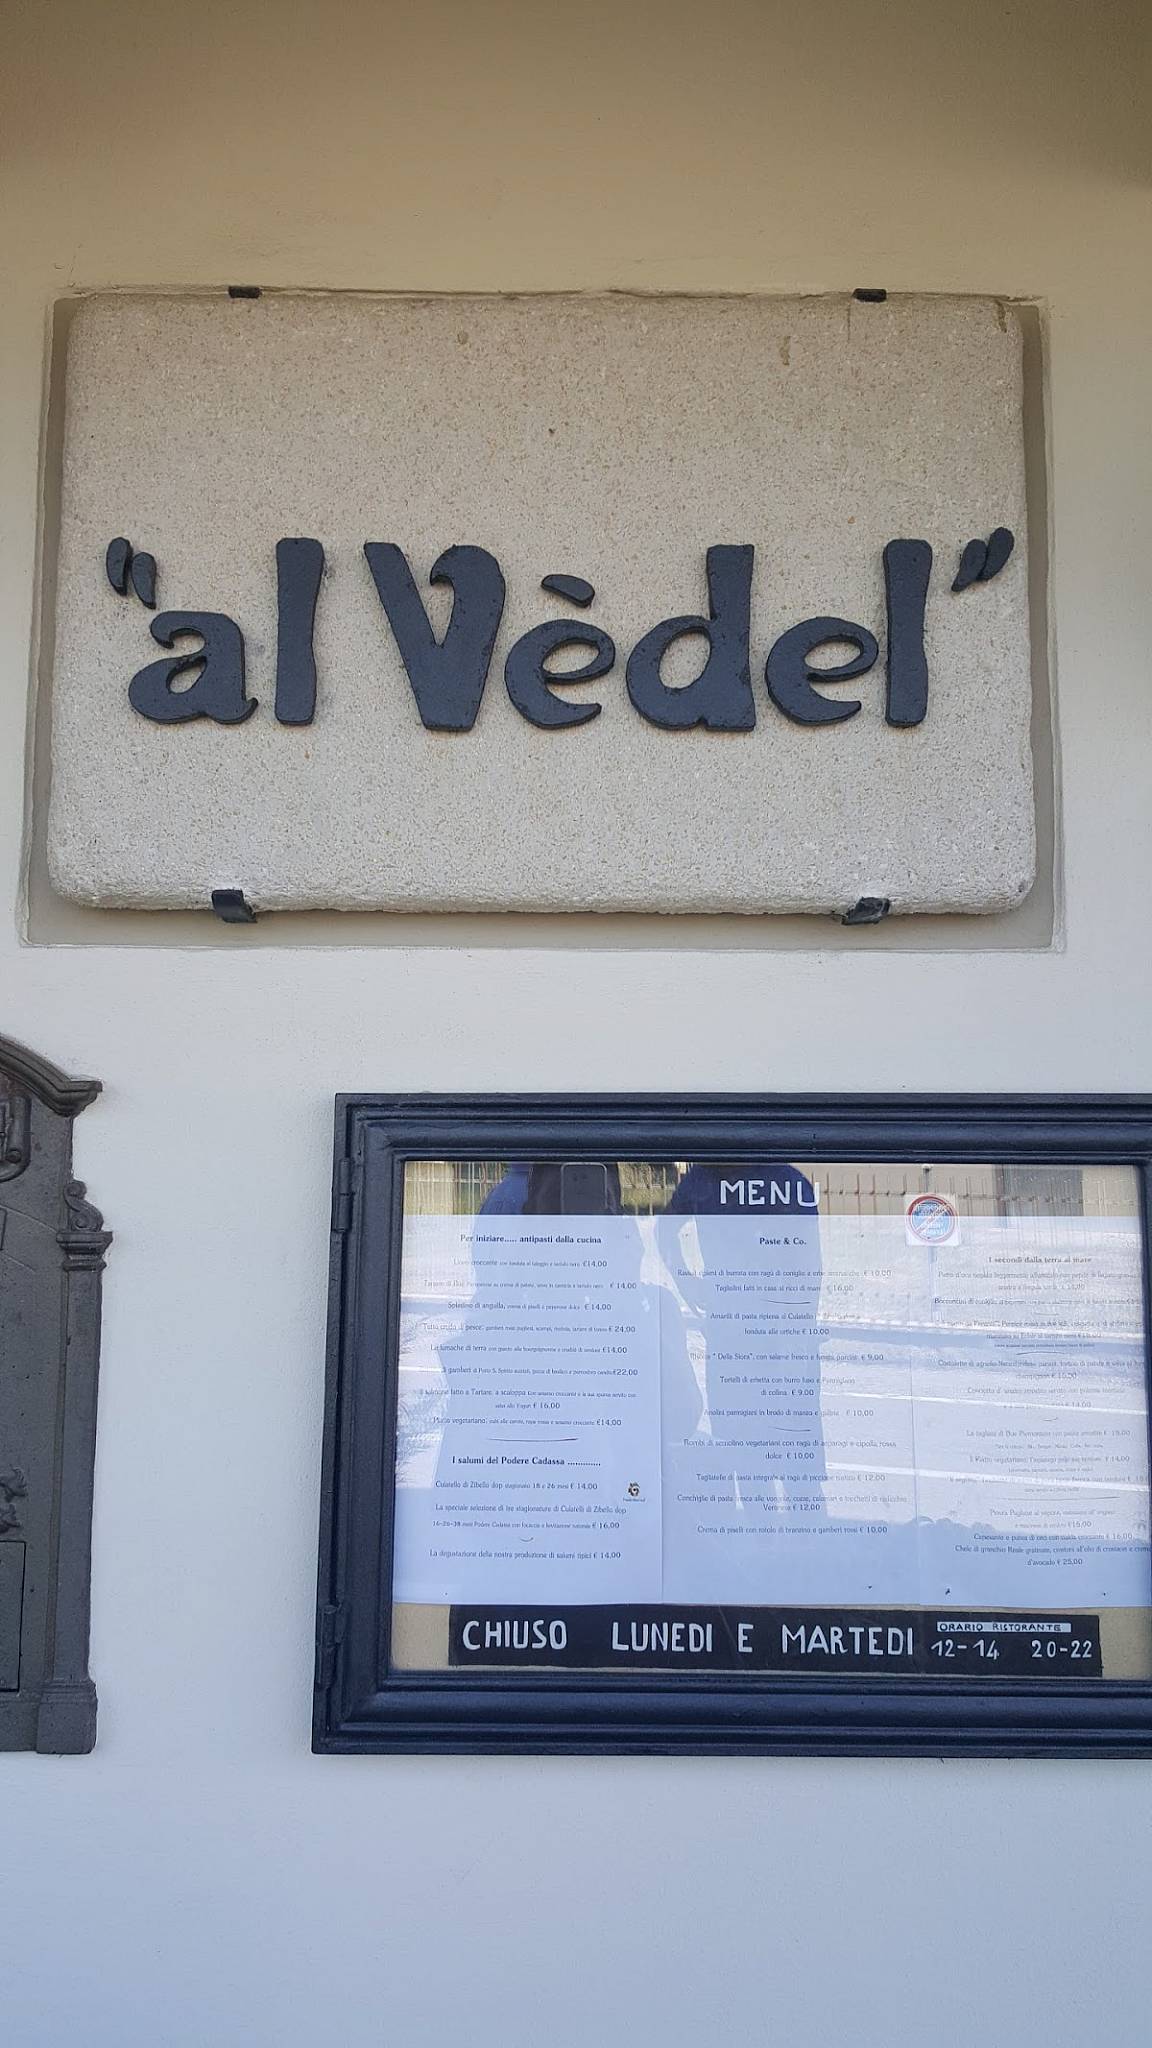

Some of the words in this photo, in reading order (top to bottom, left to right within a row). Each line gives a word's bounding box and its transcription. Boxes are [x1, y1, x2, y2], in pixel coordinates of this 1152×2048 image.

[720, 1179, 820, 1207] MENU
[520, 1235, 553, 1245] antipasti
[555, 1235, 574, 1243] dalla
[576, 1236, 602, 1244] cucina
[759, 1237, 781, 1245] Paste
[792, 1237, 807, 1245] Co.
[458, 1456, 484, 1464] salumi
[501, 1456, 530, 1464] Podere
[531, 1457, 565, 1465] Cadassa
[939, 1622, 984, 1632] ORARIO
[992, 1622, 1063, 1632] RISTORANTE
[462, 1620, 568, 1650] CHIUSO
[612, 1621, 713, 1652] LUNEDI
[737, 1623, 754, 1652] E
[781, 1624, 913, 1656] MARTEDI
[1031, 1639, 1093, 1660] 20-22
